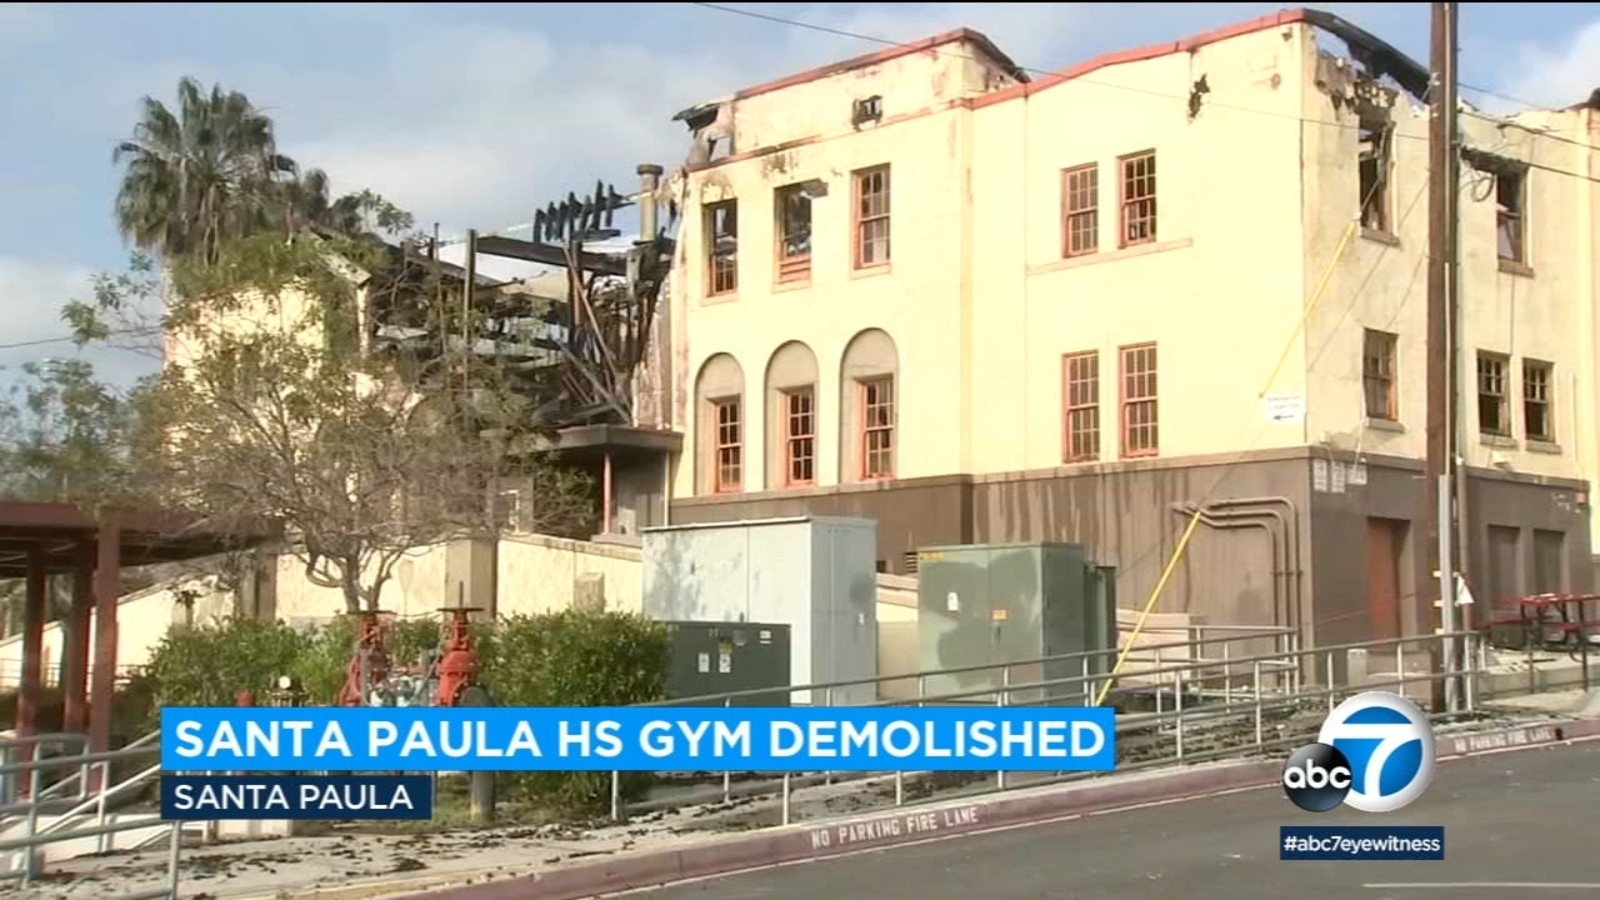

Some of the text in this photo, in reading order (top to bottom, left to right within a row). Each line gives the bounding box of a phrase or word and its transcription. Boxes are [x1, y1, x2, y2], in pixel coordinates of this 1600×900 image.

[811, 806, 980, 849] NO PARKING FIRE LANE
